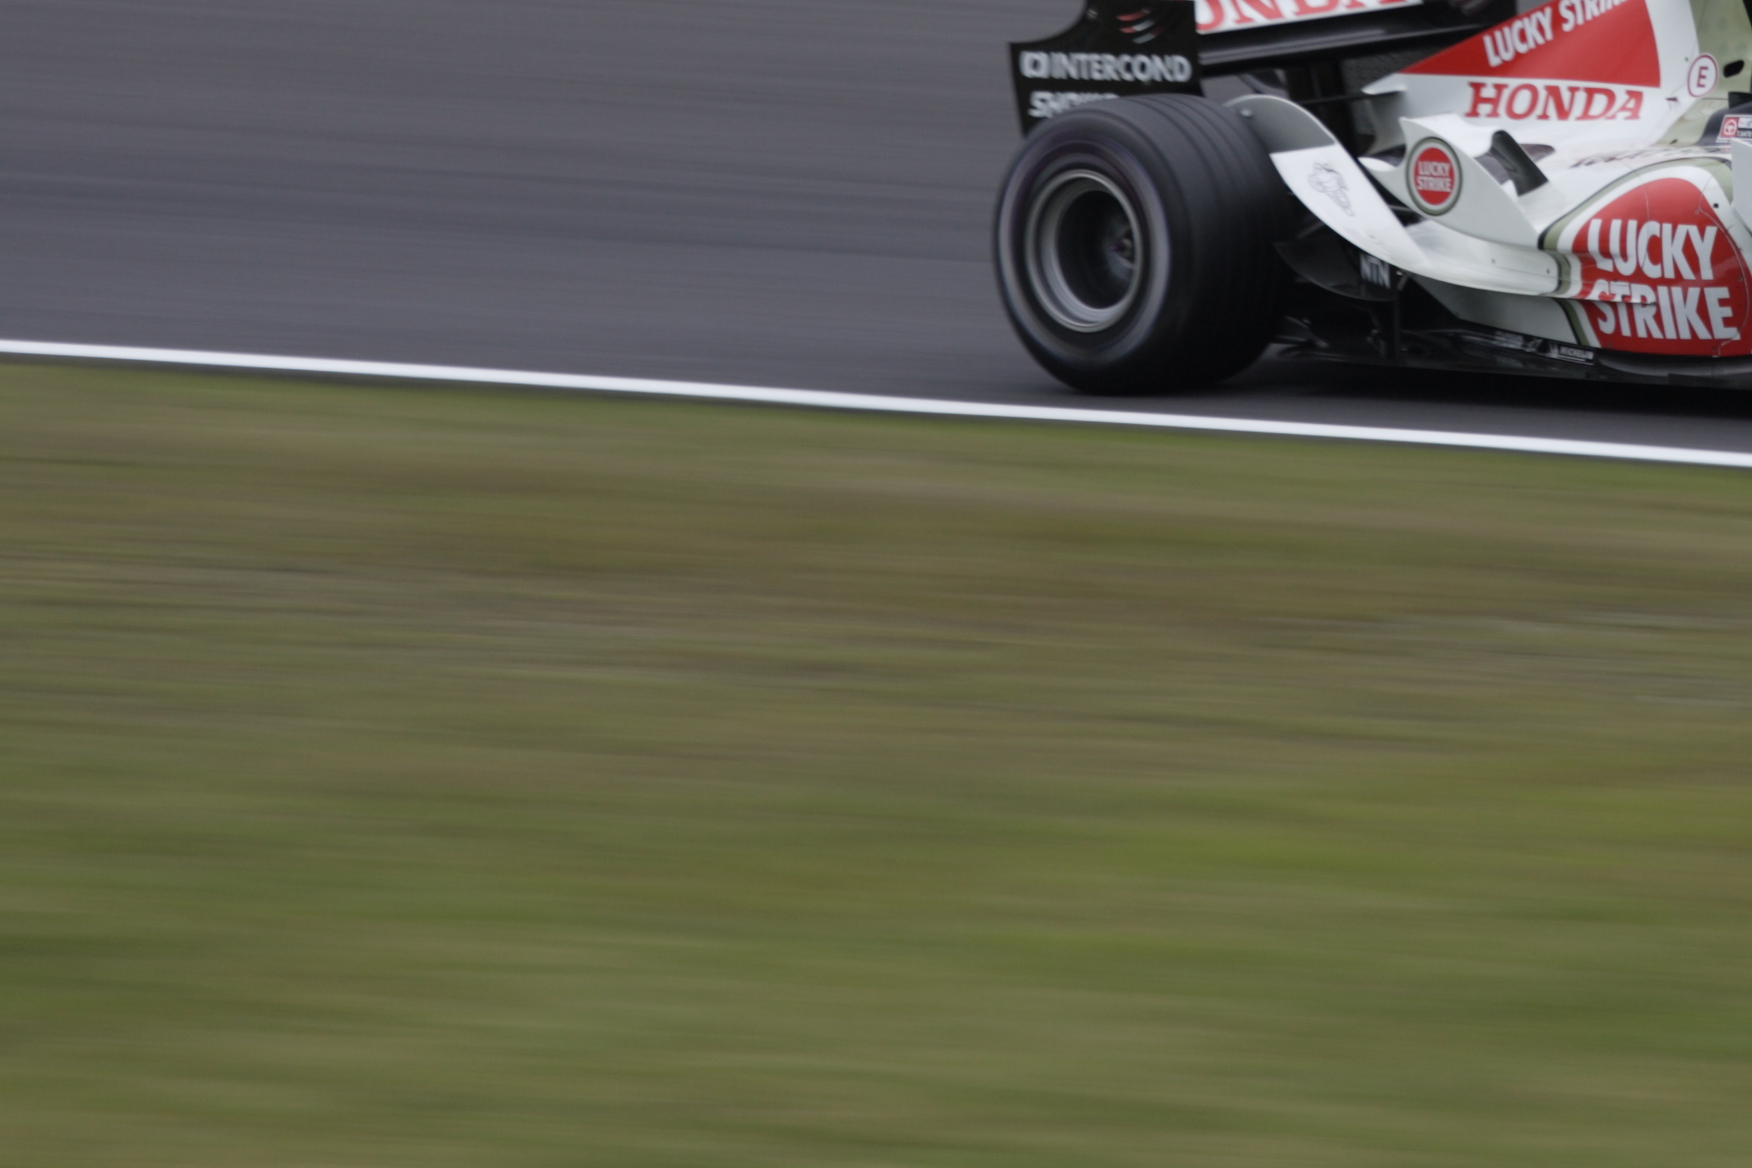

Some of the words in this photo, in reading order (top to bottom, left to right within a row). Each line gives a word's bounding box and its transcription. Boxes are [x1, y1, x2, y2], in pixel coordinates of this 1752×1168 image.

[1482, 6, 1554, 68] LUCKY
[1050, 50, 1193, 83] INTERCOND
[1696, 65, 1708, 88] E
[1465, 82, 1644, 121] HONDA
[1416, 175, 1454, 192] STRIKE
[1417, 160, 1451, 177] LUCKY
[1586, 219, 1719, 281] LUCKY
[1588, 279, 1742, 341] STRIKE
